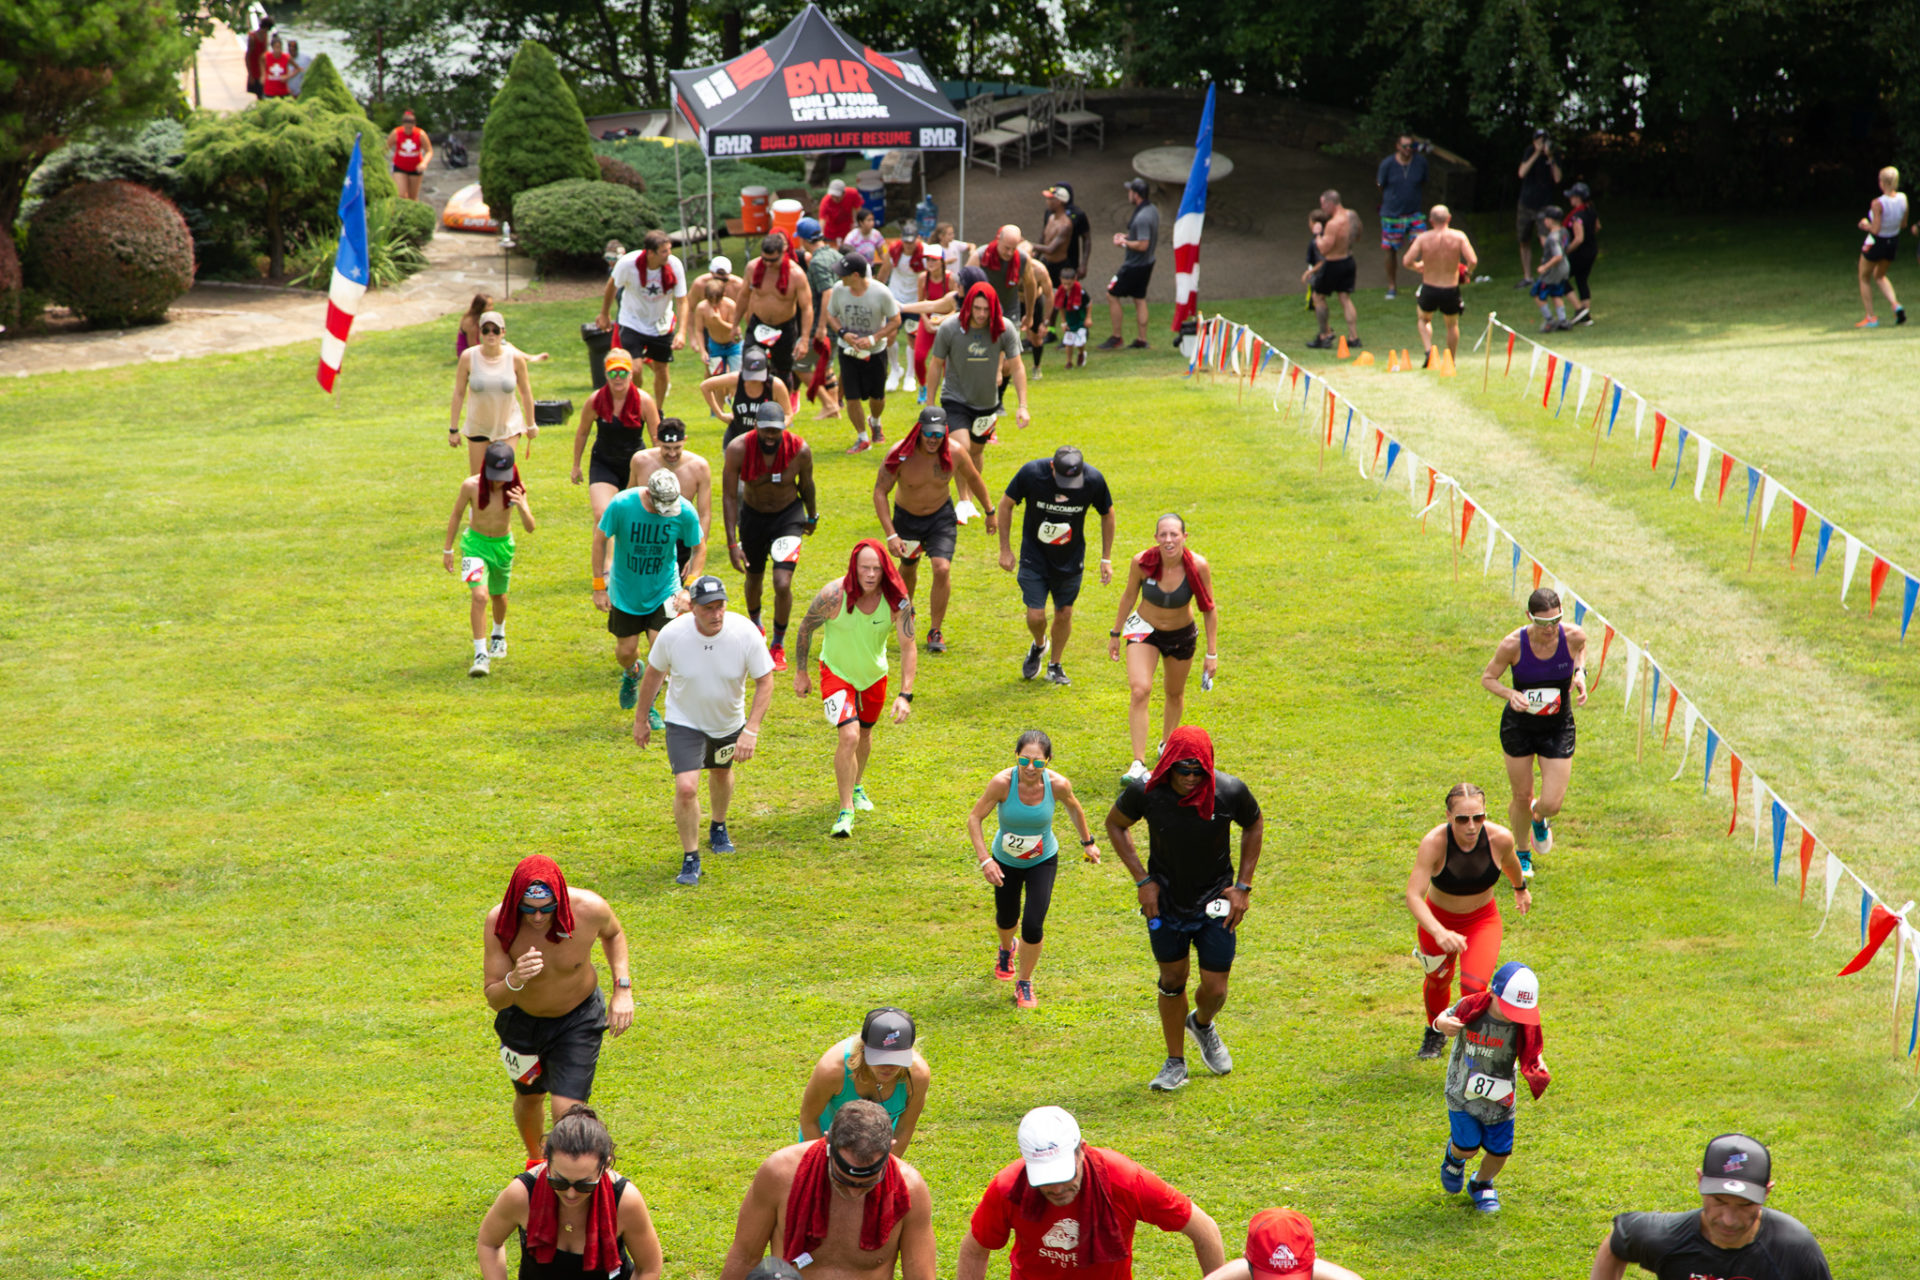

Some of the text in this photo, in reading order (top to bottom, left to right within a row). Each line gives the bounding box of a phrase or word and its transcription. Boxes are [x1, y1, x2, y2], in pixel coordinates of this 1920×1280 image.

[782, 58, 874, 98] BYLR
[789, 92, 879, 110] BUILD YOUR
[791, 105, 890, 122] LIFE RESUME
[714, 134, 753, 155] BYLR
[760, 131, 912, 150] BUILD YOUR LIFE RESUME
[919, 127, 957, 148] BYLR
[844, 304, 873, 317] FISH
[977, 418, 989, 428] 23
[1046, 503, 1084, 513] UNCOMMON
[630, 521, 671, 545] HILLS
[1043, 524, 1058, 536] 37
[776, 538, 789, 551] 35
[1127, 613, 1141, 629] 42
[1528, 691, 1543, 703] 54
[824, 699, 837, 715] 73
[1008, 835, 1025, 850] 22
[1517, 990, 1534, 1001] HELL
[1466, 1029, 1505, 1049] HELLION
[1477, 1046, 1495, 1058] THE
[505, 1051, 520, 1070] 44
[1474, 1076, 1496, 1097] 87
[1039, 1248, 1078, 1263] SEMPE
